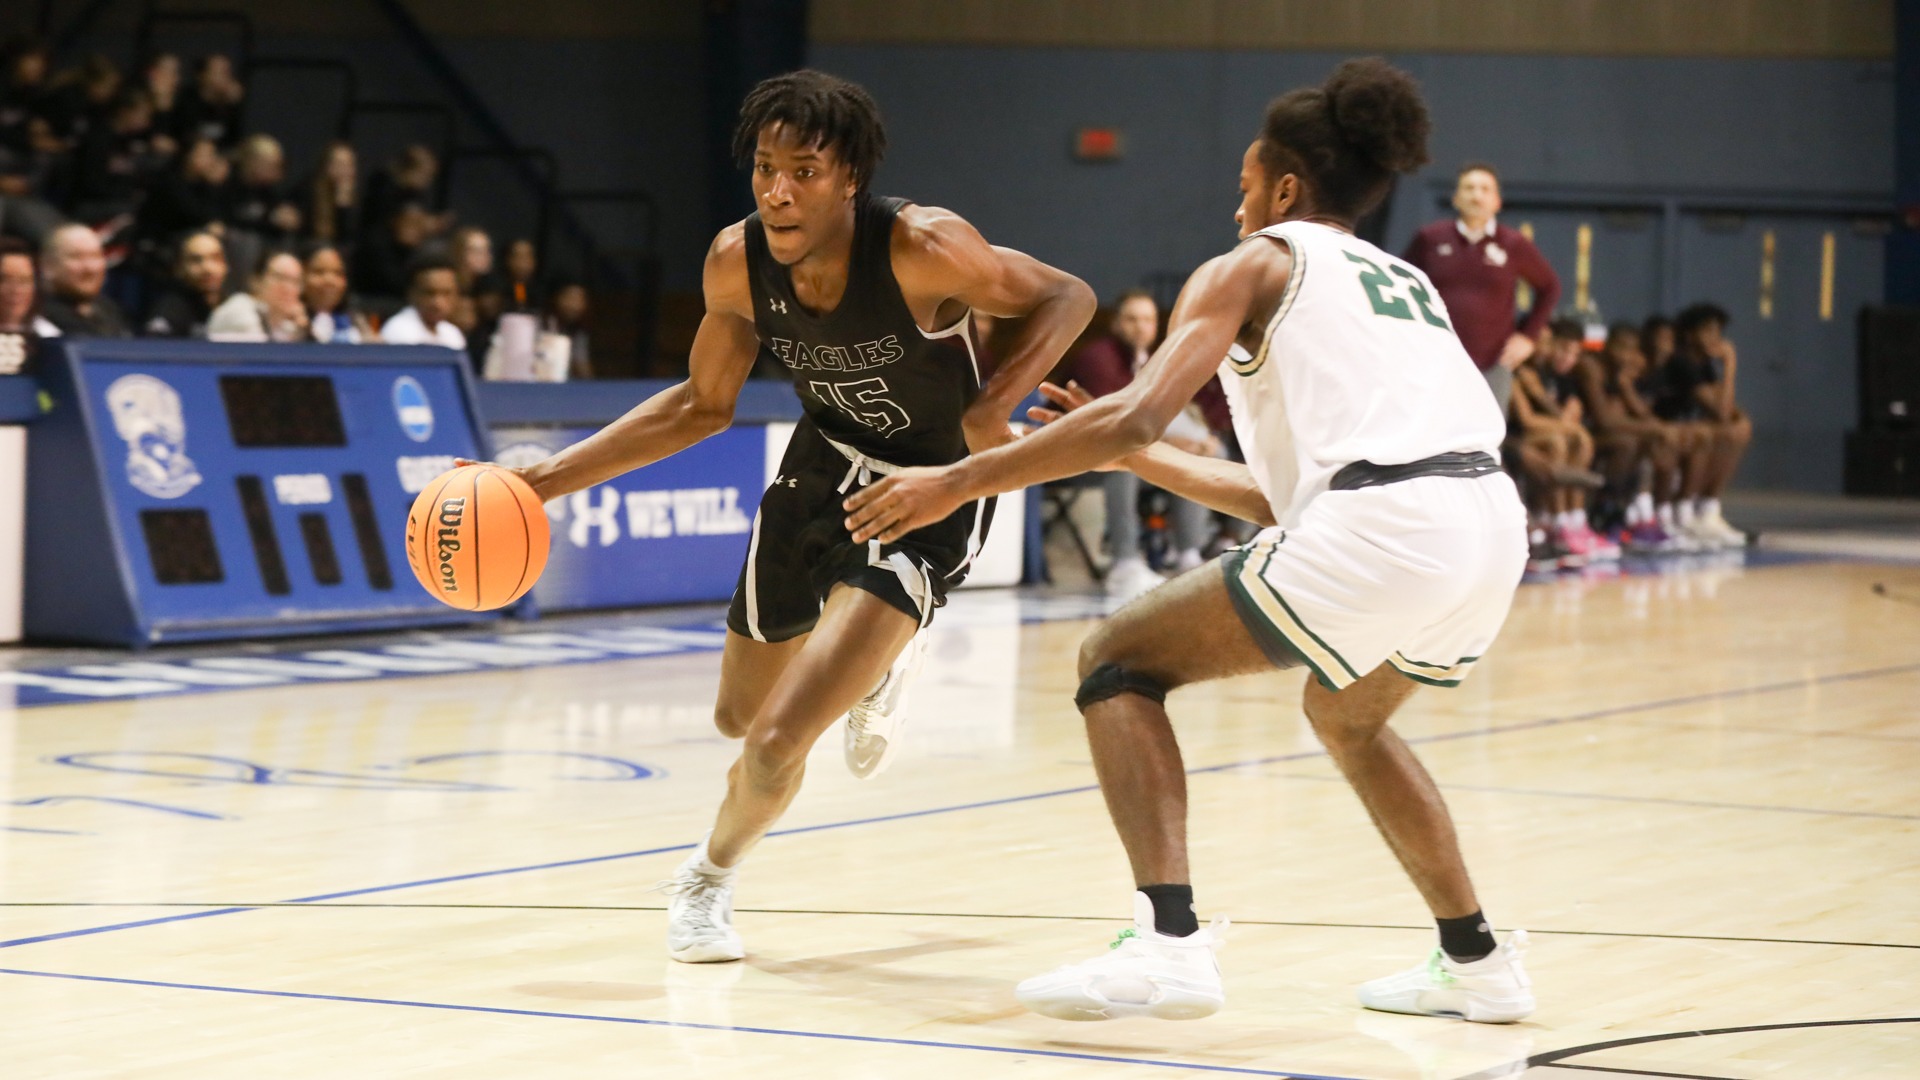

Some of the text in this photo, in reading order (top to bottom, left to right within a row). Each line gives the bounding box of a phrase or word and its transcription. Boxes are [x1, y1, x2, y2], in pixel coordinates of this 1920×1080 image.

[1341, 249, 1451, 331] 22
[771, 334, 905, 372] EAGLES
[808, 376, 911, 438] 15
[437, 496, 467, 593] Wilson
[624, 490, 672, 539] WE
